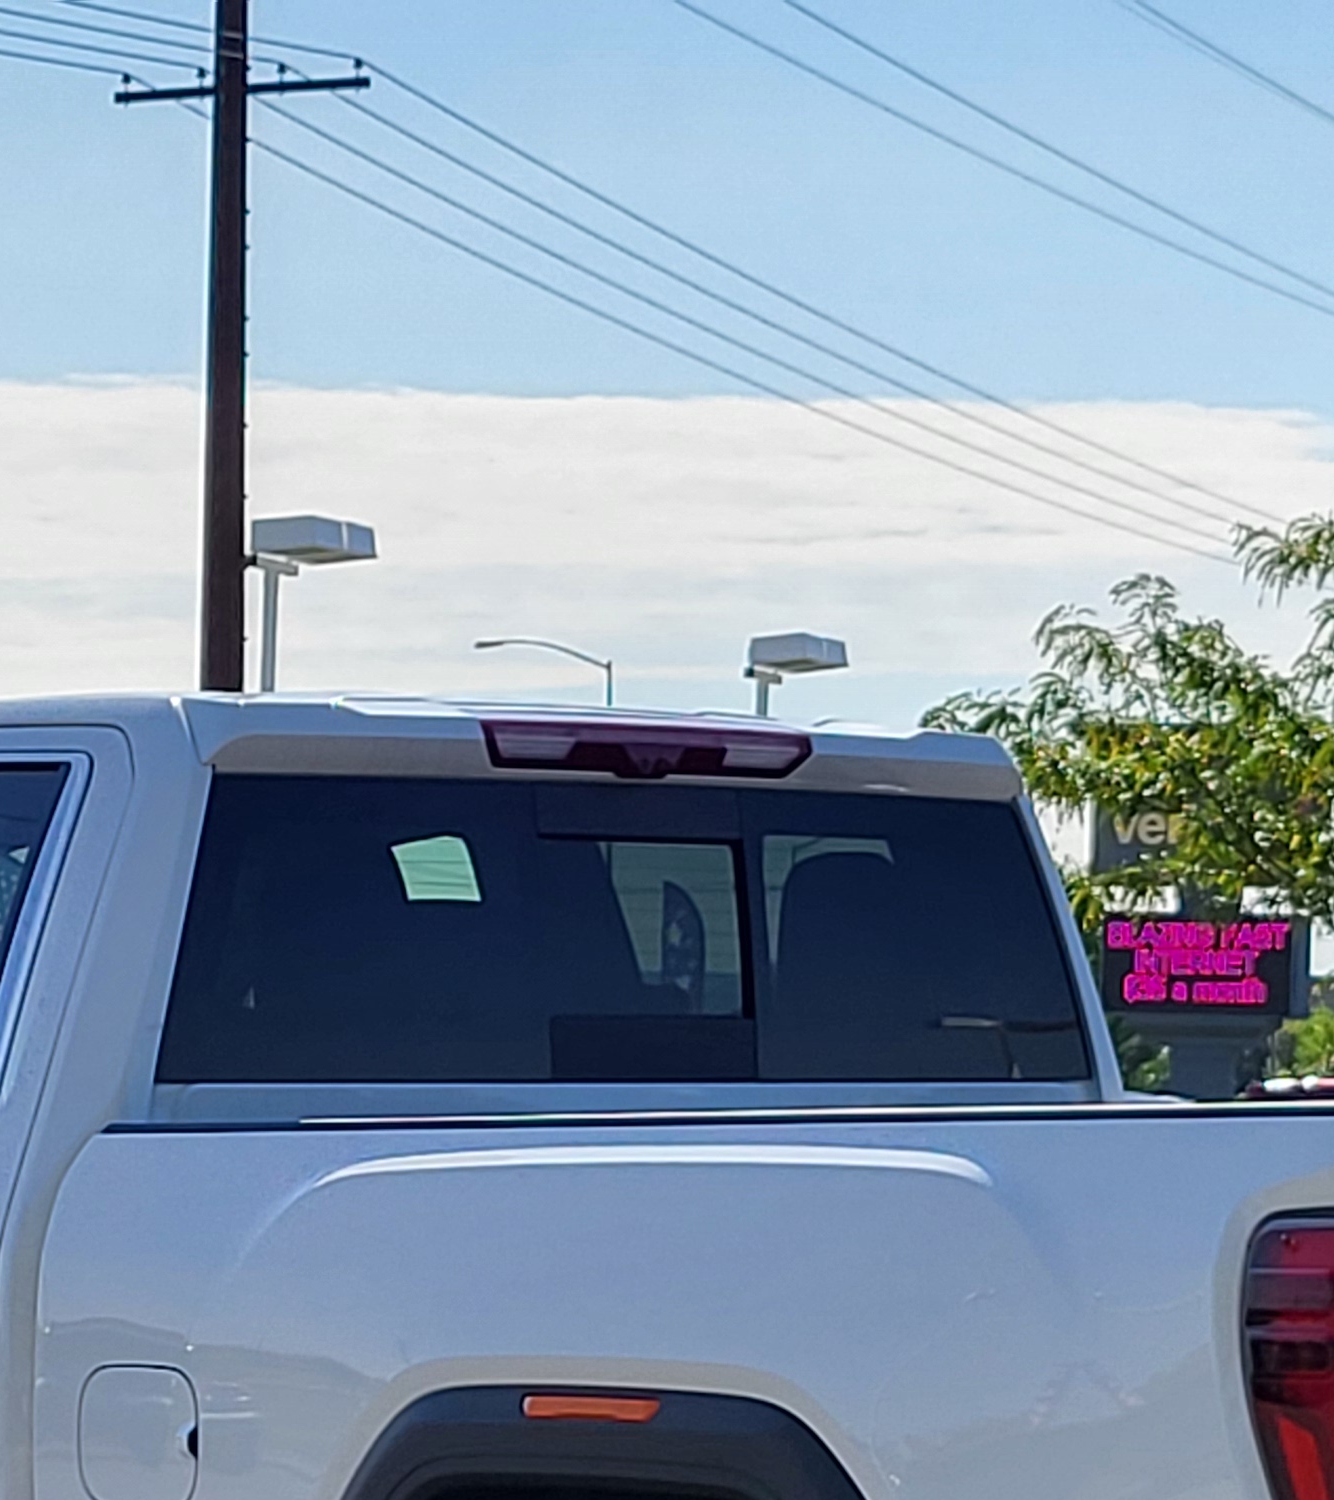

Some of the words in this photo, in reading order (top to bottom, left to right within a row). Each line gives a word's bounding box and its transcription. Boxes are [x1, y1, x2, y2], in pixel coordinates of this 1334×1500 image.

[1220, 921, 1291, 950] FAST
[1134, 949, 1260, 976] INTERNET
[1171, 981, 1188, 1002] a
[1192, 976, 1268, 1004] month
